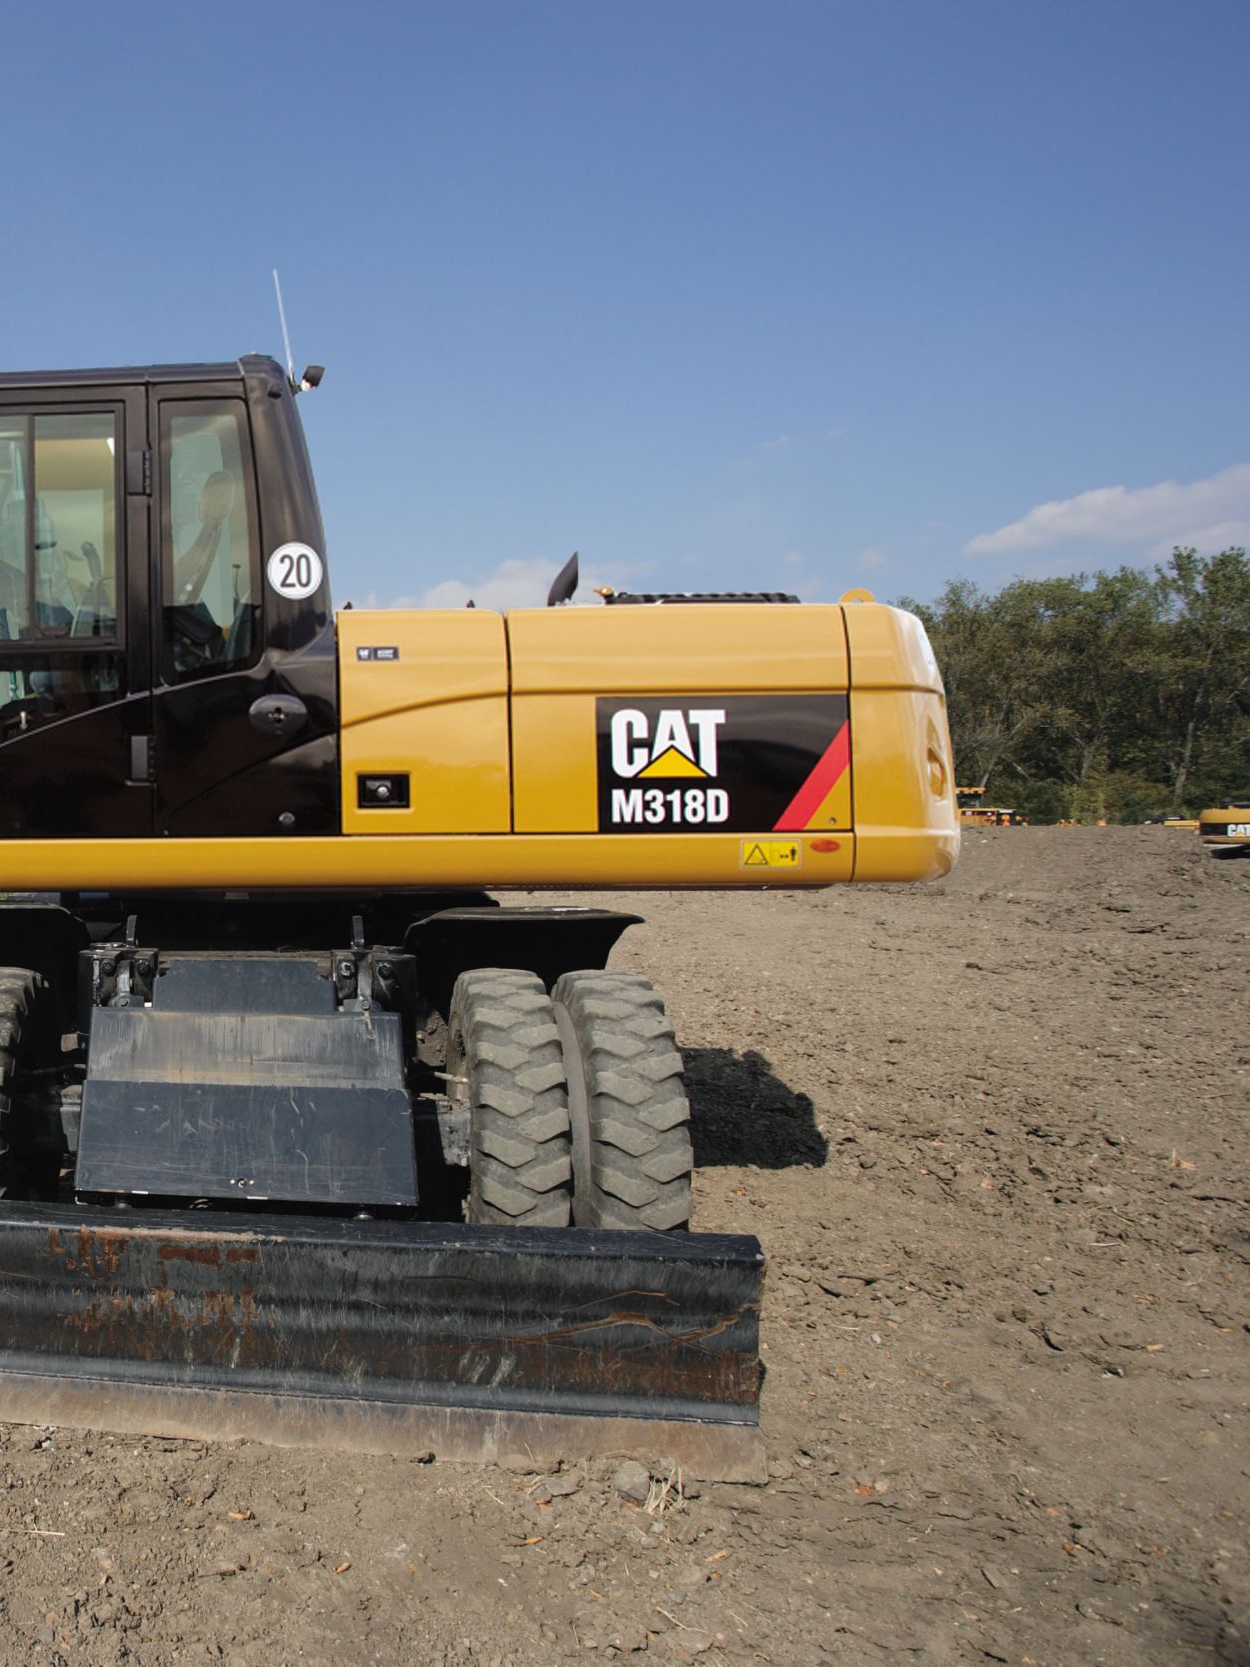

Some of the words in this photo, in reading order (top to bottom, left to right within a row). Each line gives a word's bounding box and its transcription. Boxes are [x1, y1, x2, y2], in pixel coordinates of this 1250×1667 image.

[279, 553, 312, 588] 20
[611, 709, 726, 777] CAT
[612, 789, 729, 823] M318D
